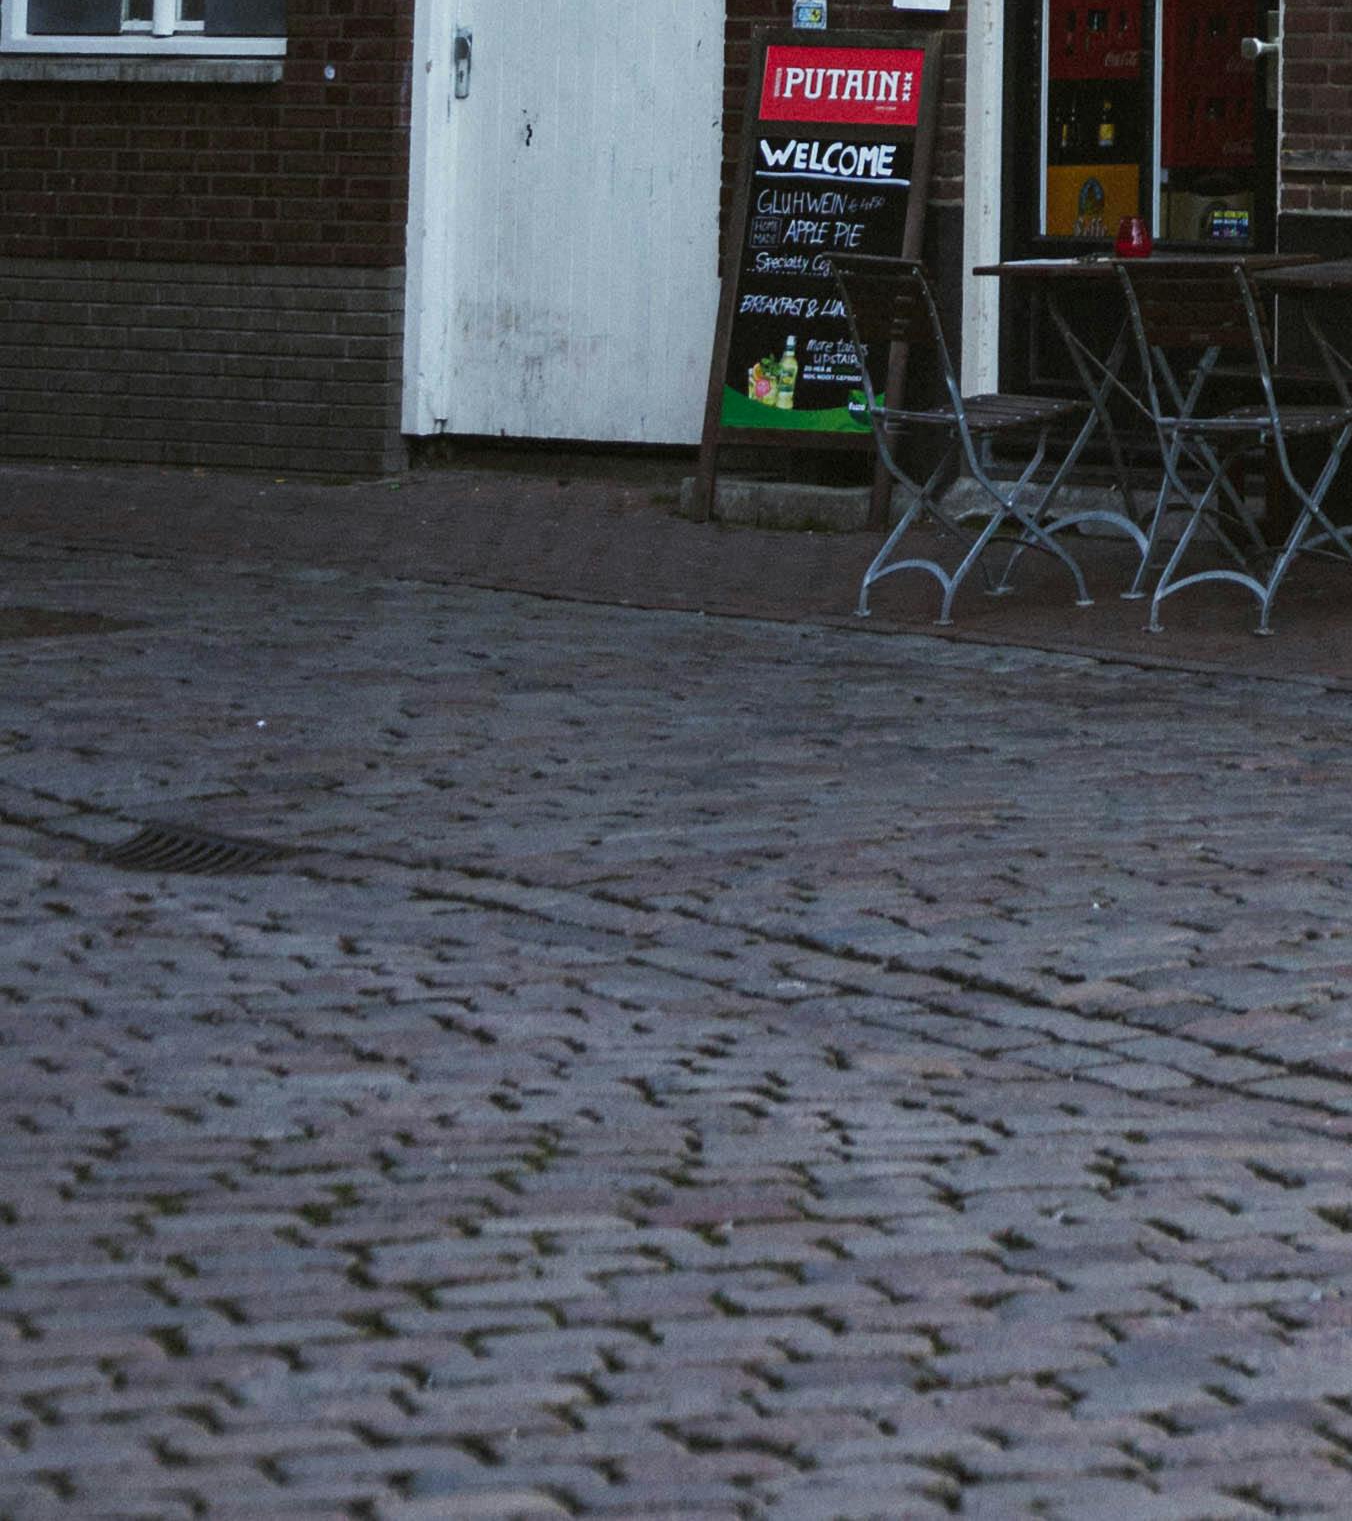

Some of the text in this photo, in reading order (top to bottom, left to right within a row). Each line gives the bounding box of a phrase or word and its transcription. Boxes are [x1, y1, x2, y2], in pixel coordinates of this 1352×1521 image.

[782, 67, 901, 102] PUTAIN
[760, 139, 897, 177] WELCOME
[757, 189, 848, 215] GLUHWEIN
[782, 219, 865, 248] APPLE PIE
[739, 294, 808, 316] BREAKFAST
